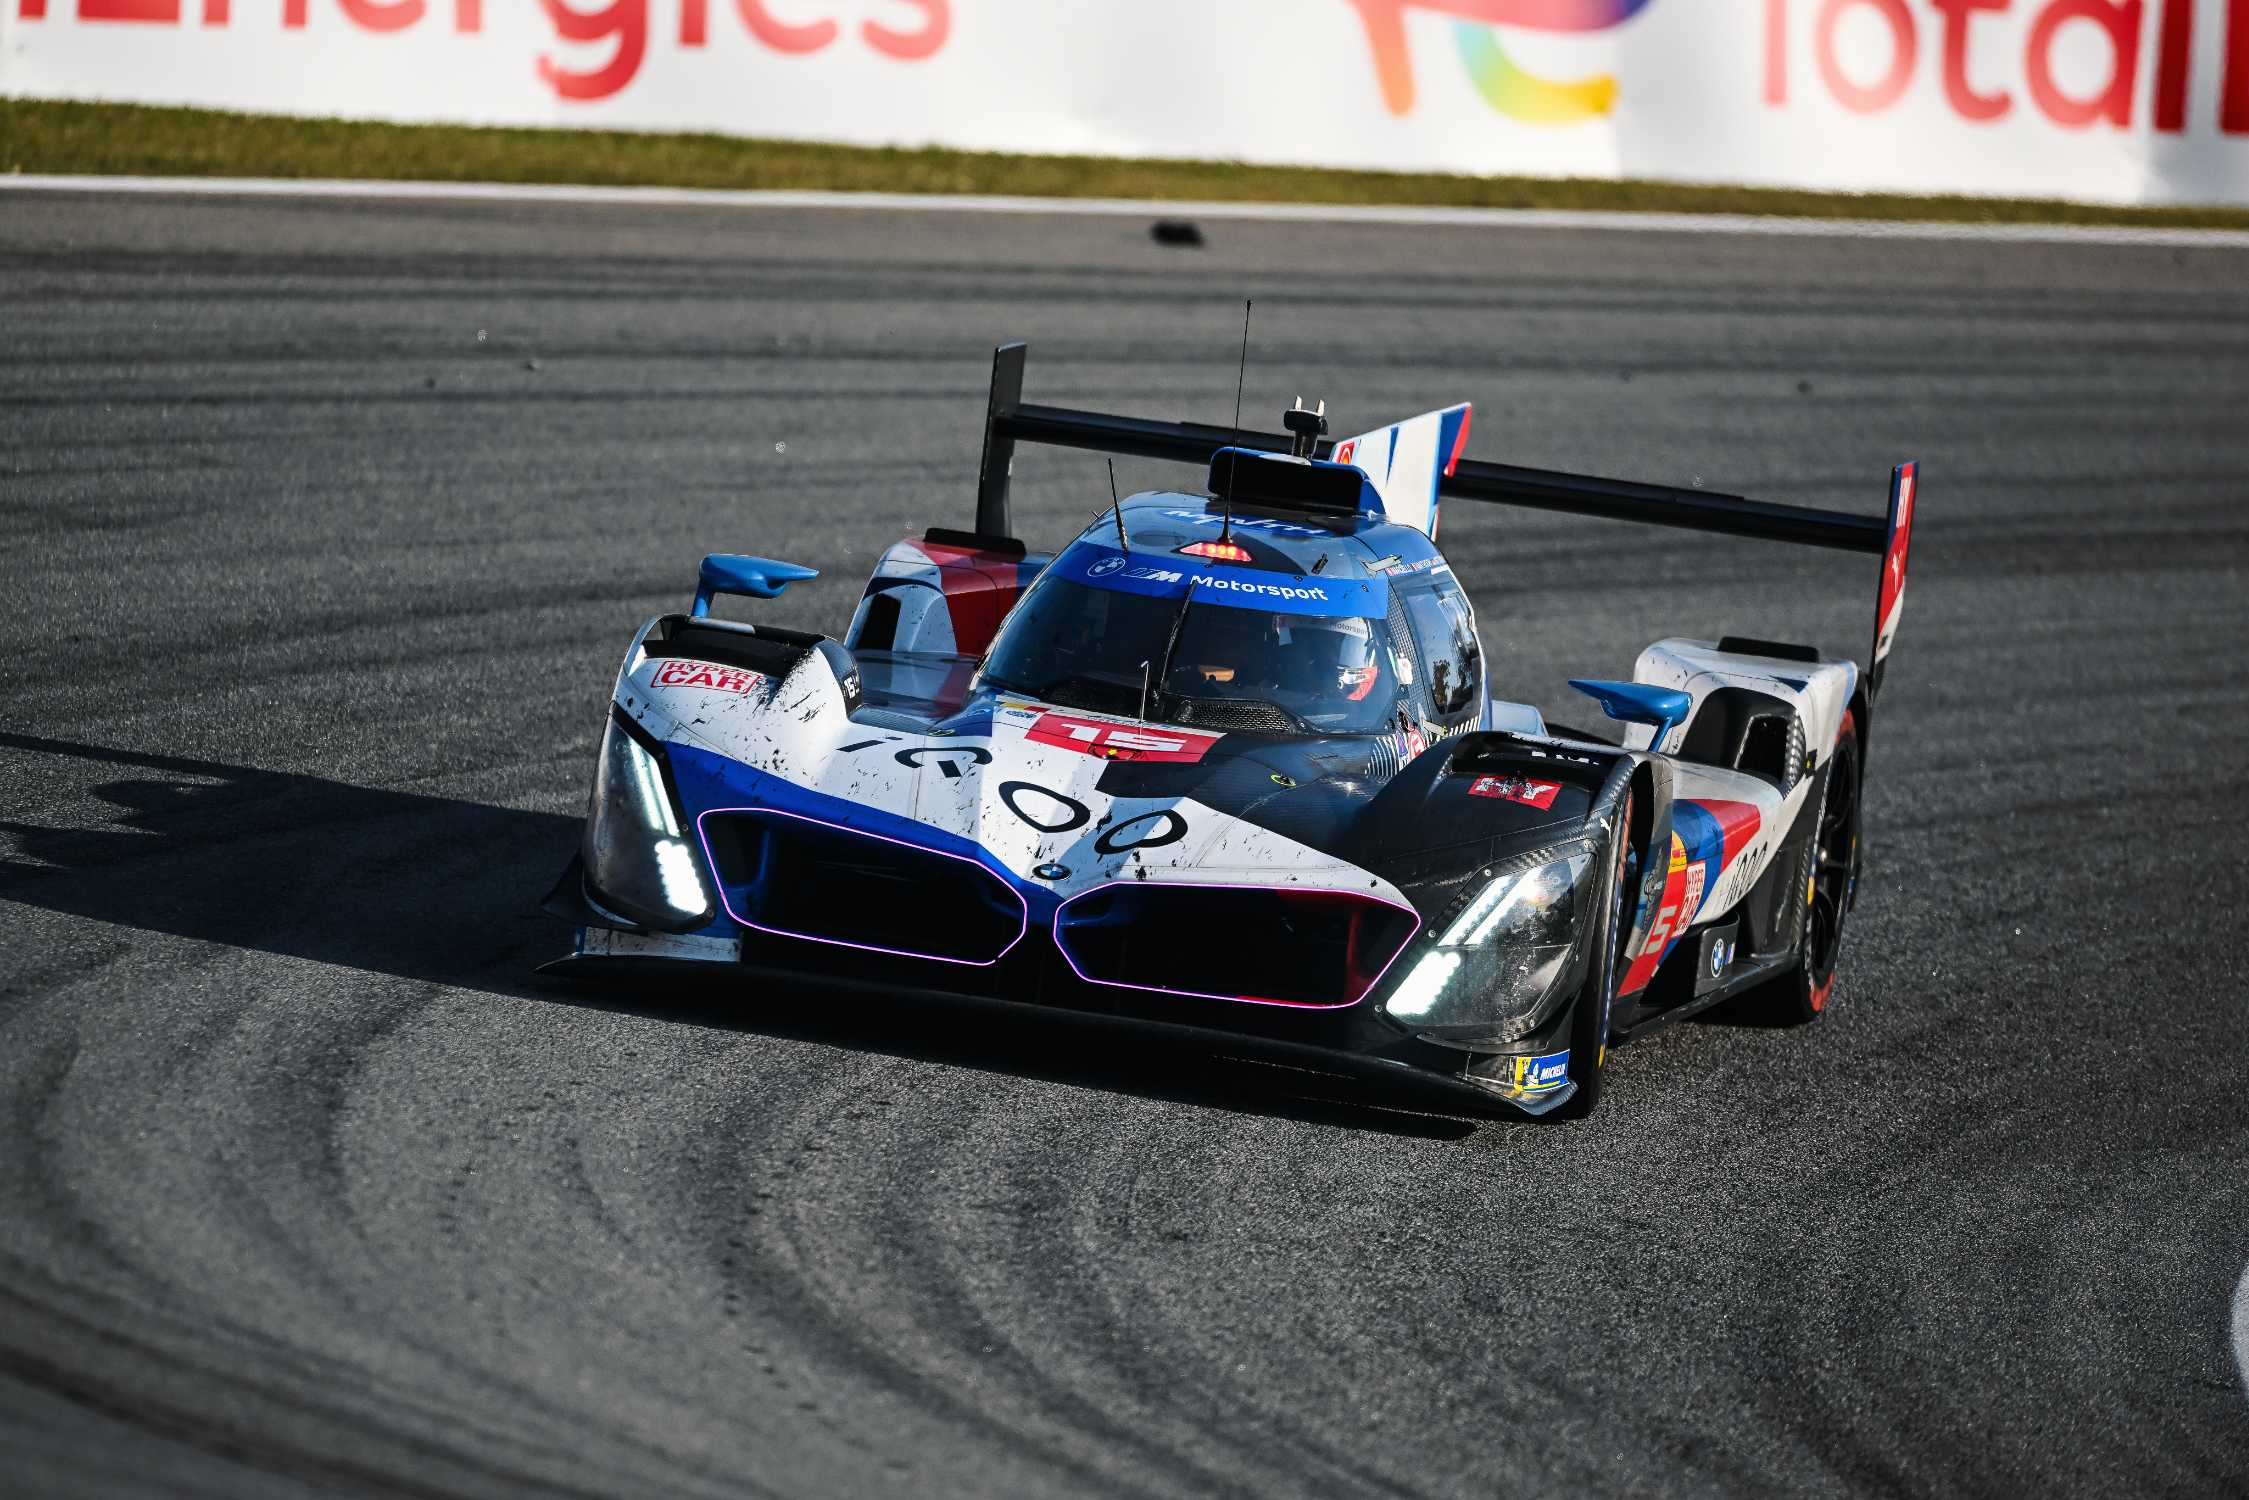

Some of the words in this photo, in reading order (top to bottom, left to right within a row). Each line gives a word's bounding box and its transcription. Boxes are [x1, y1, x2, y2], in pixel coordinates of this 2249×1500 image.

[1190, 575, 1328, 602] Motorsport
[661, 671, 746, 691] CAR
[666, 662, 751, 680] HYPER
[1061, 723, 1187, 752] 15
